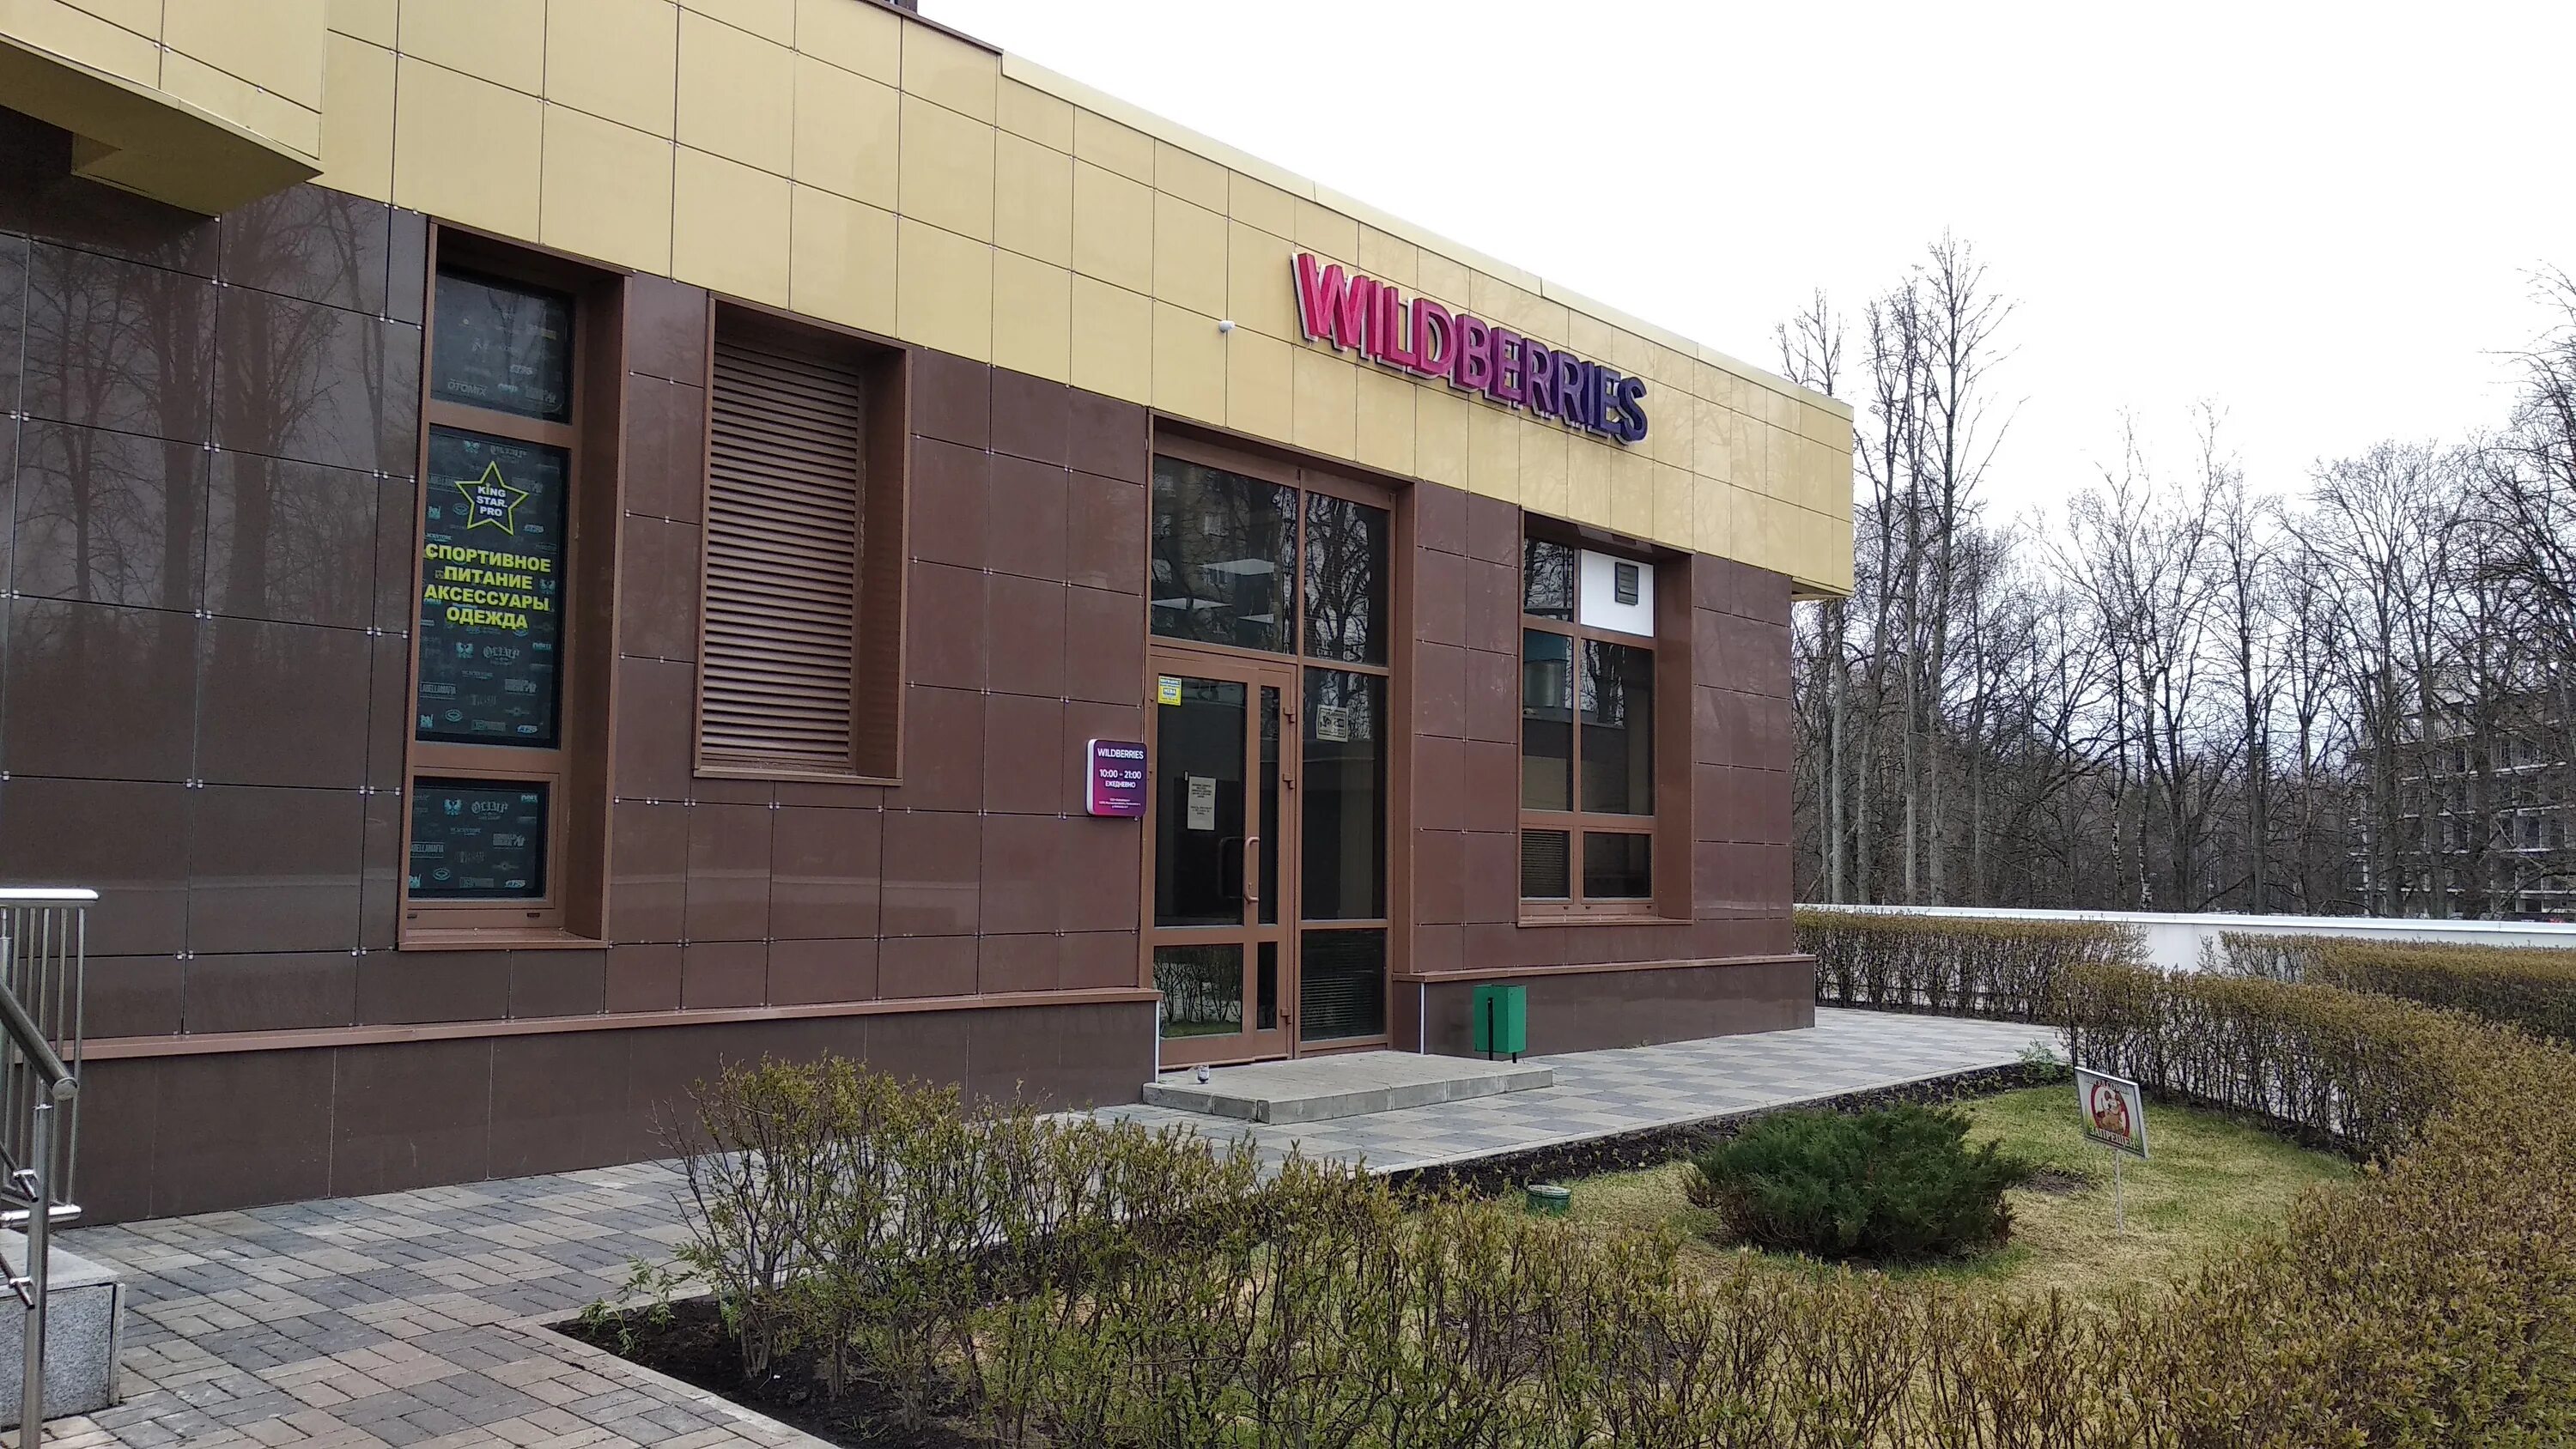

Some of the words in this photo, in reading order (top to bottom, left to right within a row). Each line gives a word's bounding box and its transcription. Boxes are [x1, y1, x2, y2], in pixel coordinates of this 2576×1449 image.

[1291, 252, 1648, 445] WILDBERRIES
[479, 506, 503, 517] PRO
[425, 543, 551, 573] СПОРТИВНОЕ
[444, 566, 533, 591] ПИТАНИЕ
[424, 584, 550, 611] АКСЕССУАРЫ
[446, 606, 528, 630] ОДЕЖДА
[1097, 748, 1144, 759] WILDBERRIES
[1099, 769, 1118, 778] 10:00
[1124, 770, 1142, 779] 21:00
[2090, 1128, 2139, 1149] ЗАПРЕЩЕН!
